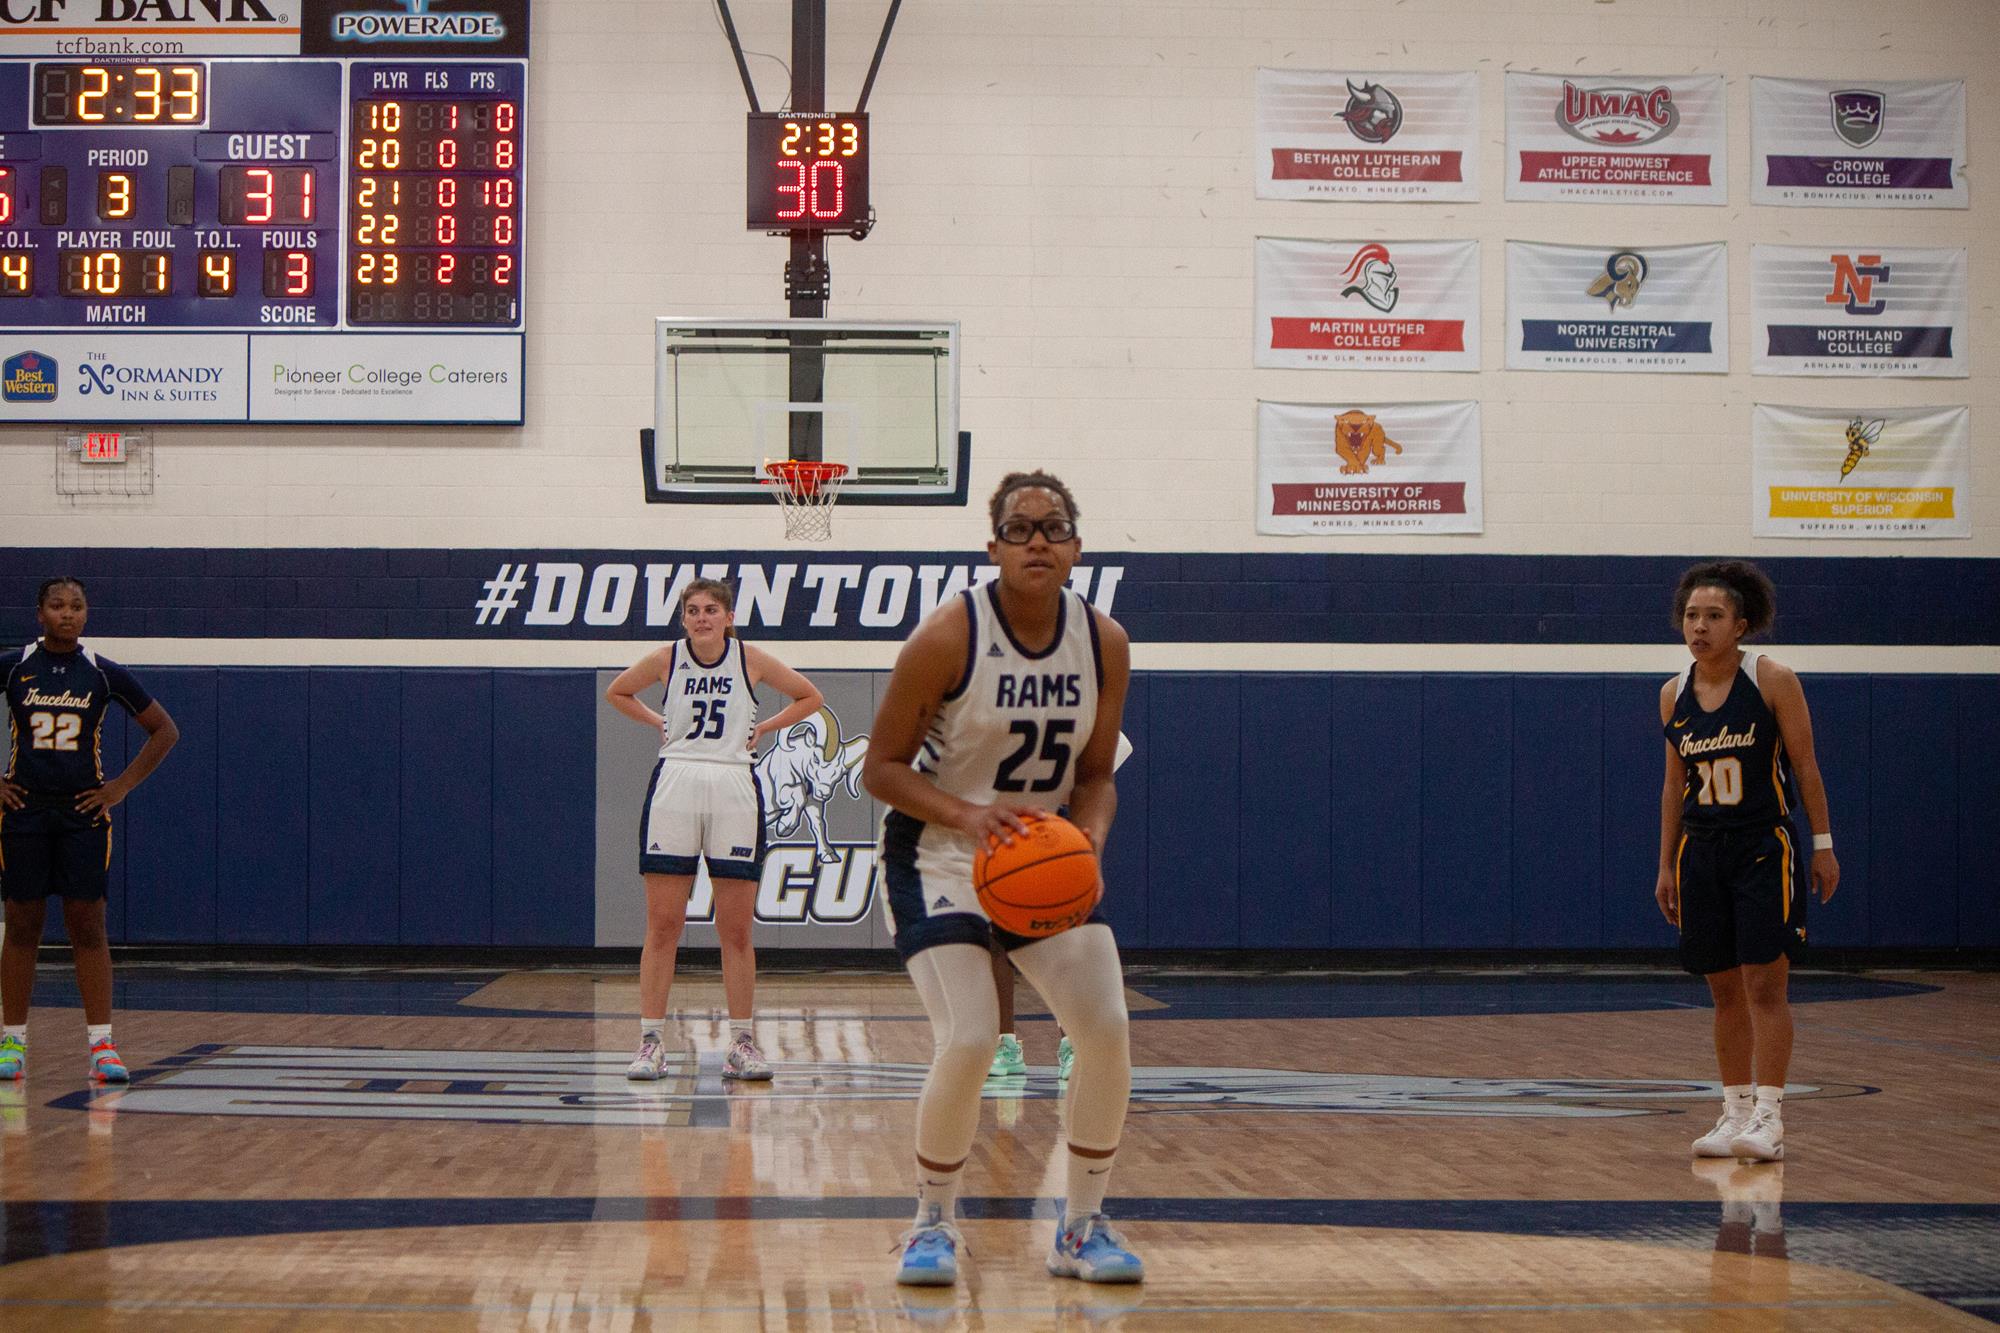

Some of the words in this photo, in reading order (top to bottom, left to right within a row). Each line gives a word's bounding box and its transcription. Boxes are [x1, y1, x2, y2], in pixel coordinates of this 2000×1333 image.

[338, 16, 495, 35] POWERADE
[56, 37, 184, 55] tcfbank.com
[373, 72, 408, 89] PLYR
[425, 72, 449, 89] FLS
[470, 72, 495, 89] PTS
[78, 68, 198, 120] 2:33
[1563, 79, 1672, 128] UMAC
[371, 103, 400, 132] 10
[451, 105, 457, 130] 1
[496, 103, 514, 132] 0
[228, 134, 310, 160] GUEST
[782, 123, 857, 156] 2:33
[88, 149, 148, 166] PERIOD
[359, 139, 400, 168] 20
[439, 139, 456, 168] 0
[496, 139, 513, 168] 8
[1294, 152, 1360, 165] BETHANY
[1365, 154, 1441, 166] LUTHERAN
[1562, 156, 1606, 168] UPPER
[1610, 157, 1670, 169] MIDWEST
[1333, 167, 1401, 179] COLLEGE
[1538, 168, 1601, 181] ATHLETIC
[1604, 169, 1694, 182] CONFERENCE
[1833, 160, 1885, 172] CROWN
[1826, 172, 1891, 185] COLLEGE
[108, 175, 129, 216] 3
[246, 170, 311, 222] 31
[359, 178, 399, 208] 21
[438, 179, 456, 207] 0
[484, 179, 513, 207] 10
[778, 161, 842, 218] 30
[358, 215, 399, 244] 22
[438, 215, 456, 244] 0
[495, 215, 512, 244] 0
[0, 231, 38, 248] .O.L.
[57, 231, 121, 248] PLAYER
[133, 231, 175, 248] FOUL
[195, 231, 241, 248] T.O.L.
[262, 231, 317, 248] FOULS
[3, 256, 27, 291] 4
[83, 253, 120, 294] 10
[158, 256, 165, 291] 1
[206, 256, 229, 291] 4
[287, 253, 308, 294] 3
[357, 254, 398, 283] 23
[437, 254, 455, 283] 2
[494, 255, 511, 283] 2
[86, 305, 146, 323] MATCH
[261, 305, 317, 323] SCORE
[1310, 322, 1364, 334] MARTIN
[1369, 323, 1425, 335] LUTHER
[1558, 324, 1606, 336] NORTH
[1611, 325, 1676, 337] CENTRAL
[1818, 330, 1903, 341] NORTHLAND
[1334, 335, 1401, 347] COLLEGE
[1575, 338, 1659, 350] UNIVERSITY
[1828, 342, 1893, 354] COLLEGE
[87, 352, 107, 360] THE
[15, 369, 43, 381] Best
[79, 364, 224, 395] NORMANDY
[273, 364, 342, 383] Pioneer
[348, 364, 422, 386] College
[429, 364, 508, 383] Caterers
[5, 380, 55, 394] Western
[121, 389, 148, 401] INN
[153, 389, 165, 401] &
[170, 389, 217, 401] SUITES
[87, 433, 121, 458] EXIT
[1314, 487, 1400, 499] UNIVERSITY
[1404, 487, 1423, 498] OF
[1781, 490, 1853, 502] UNIVERSITY
[1855, 491, 1873, 502] OF
[1875, 491, 1944, 502] WISCONSIN
[1296, 500, 1441, 512] MINNESOTA-MORRIS
[1831, 504, 1894, 515] SUPERIOR
[684, 676, 733, 695] RAMS
[996, 674, 1081, 708] RAMS
[23, 687, 93, 709] Graceland
[685, 699, 727, 740] 35
[29, 712, 82, 751] 22
[1680, 722, 1756, 758] Graceland
[993, 719, 1076, 792] 25
[1696, 757, 1743, 806] 10
